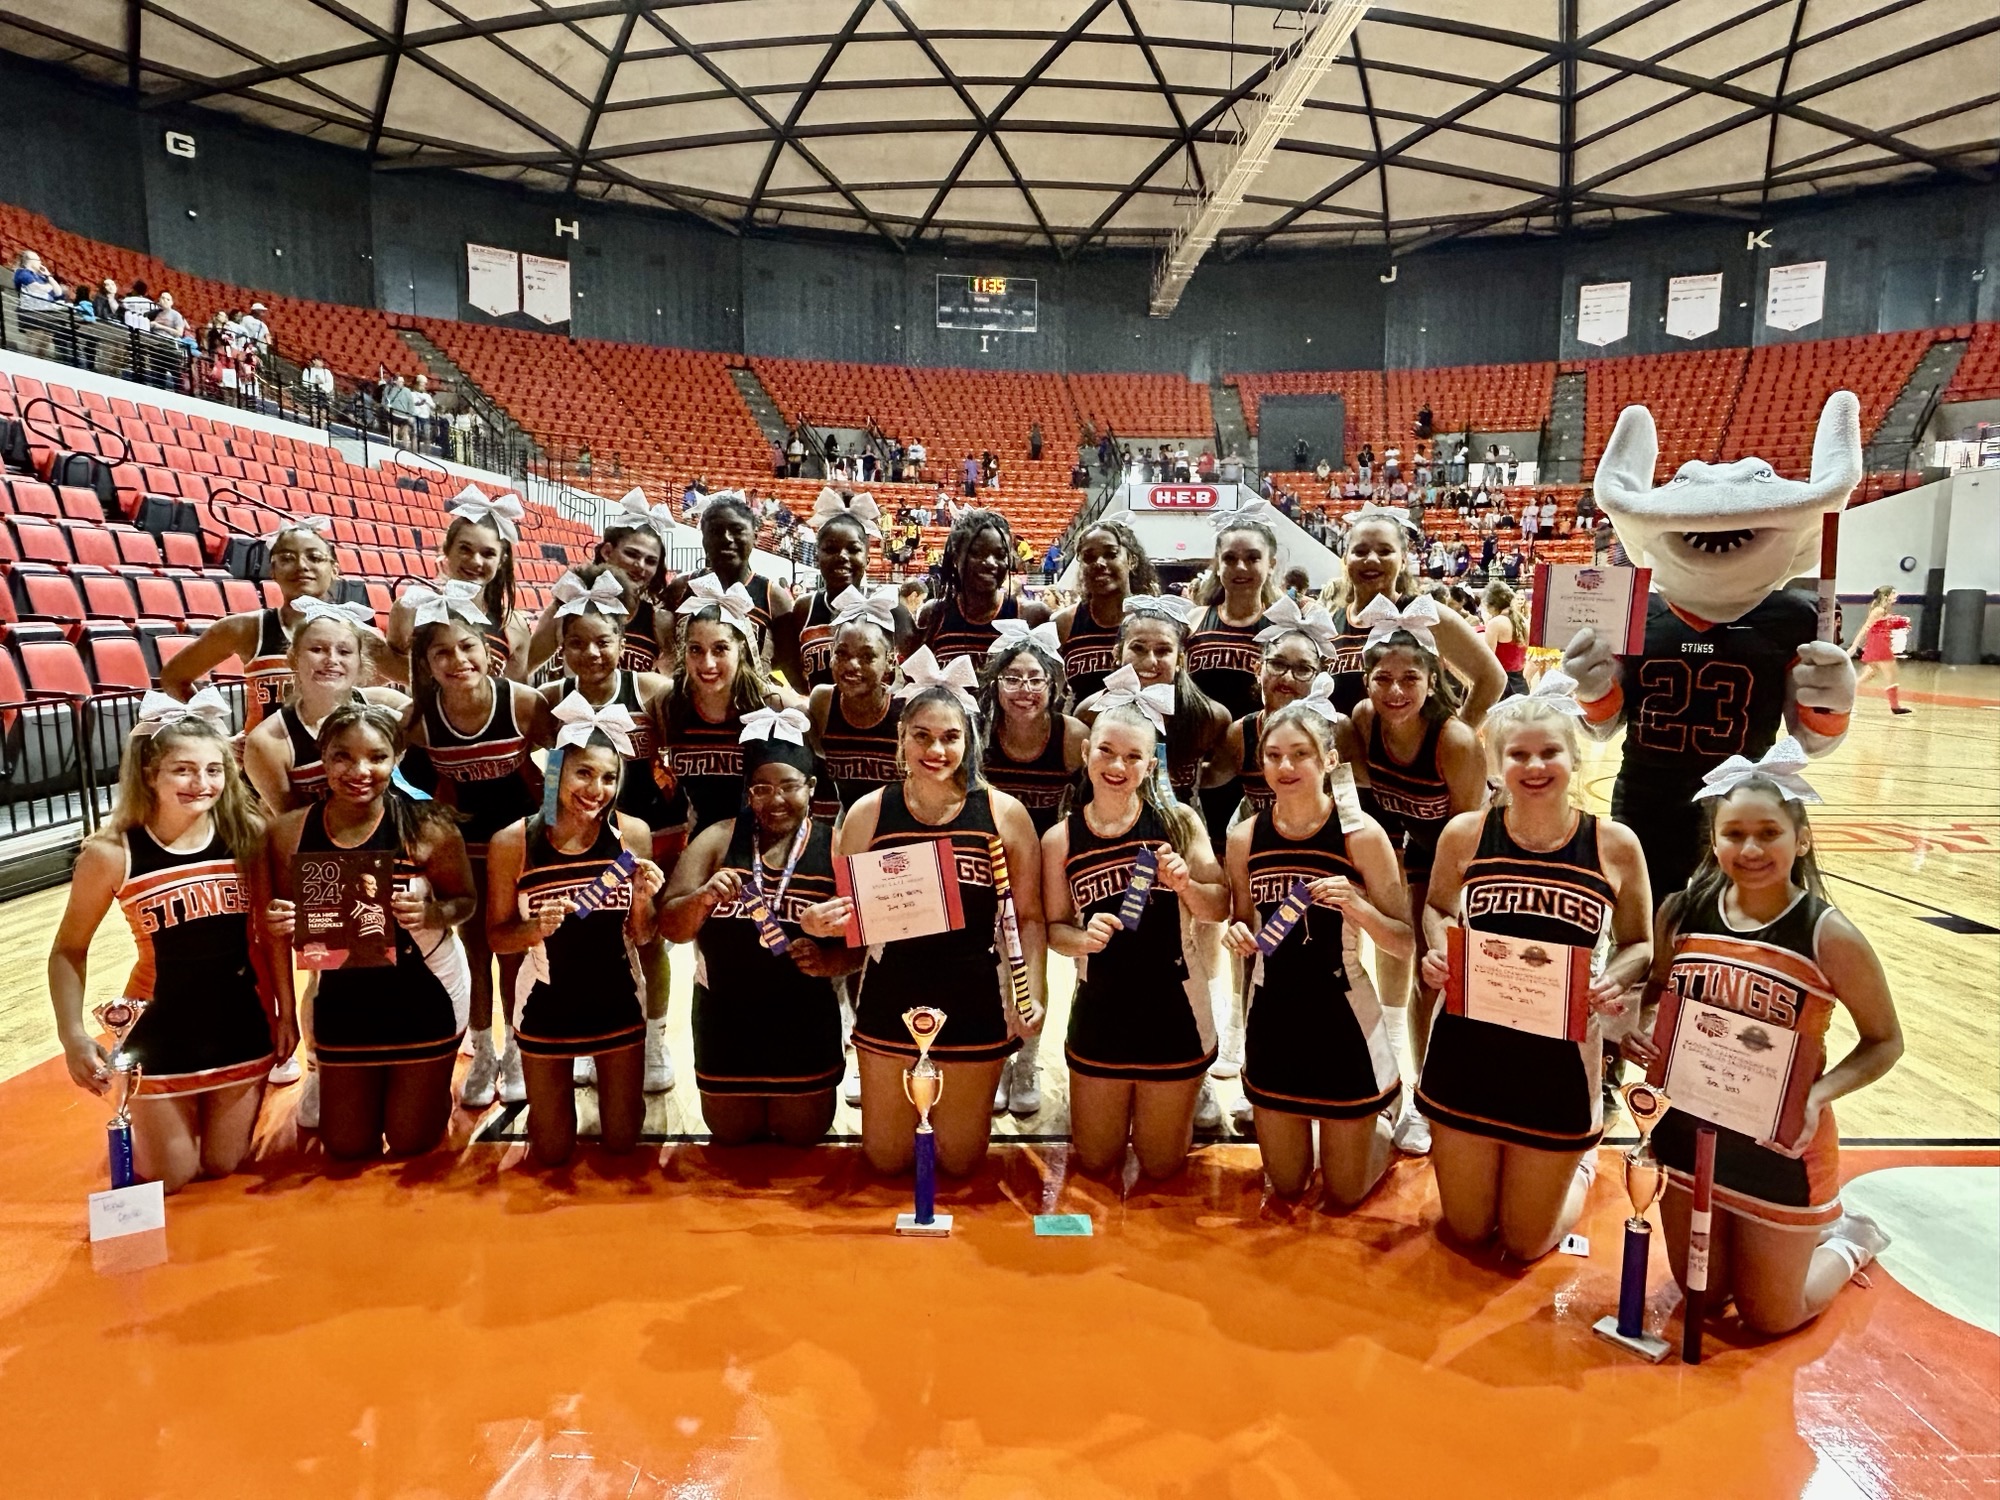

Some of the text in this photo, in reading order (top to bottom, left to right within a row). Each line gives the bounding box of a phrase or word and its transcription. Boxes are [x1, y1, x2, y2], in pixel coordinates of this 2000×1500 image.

[166, 131, 196, 158] G
[555, 218, 579, 240] H
[1746, 228, 1774, 250] K
[1380, 265, 1398, 283] J
[1638, 658, 1754, 756] 23
[1469, 882, 1602, 934] STINGS
